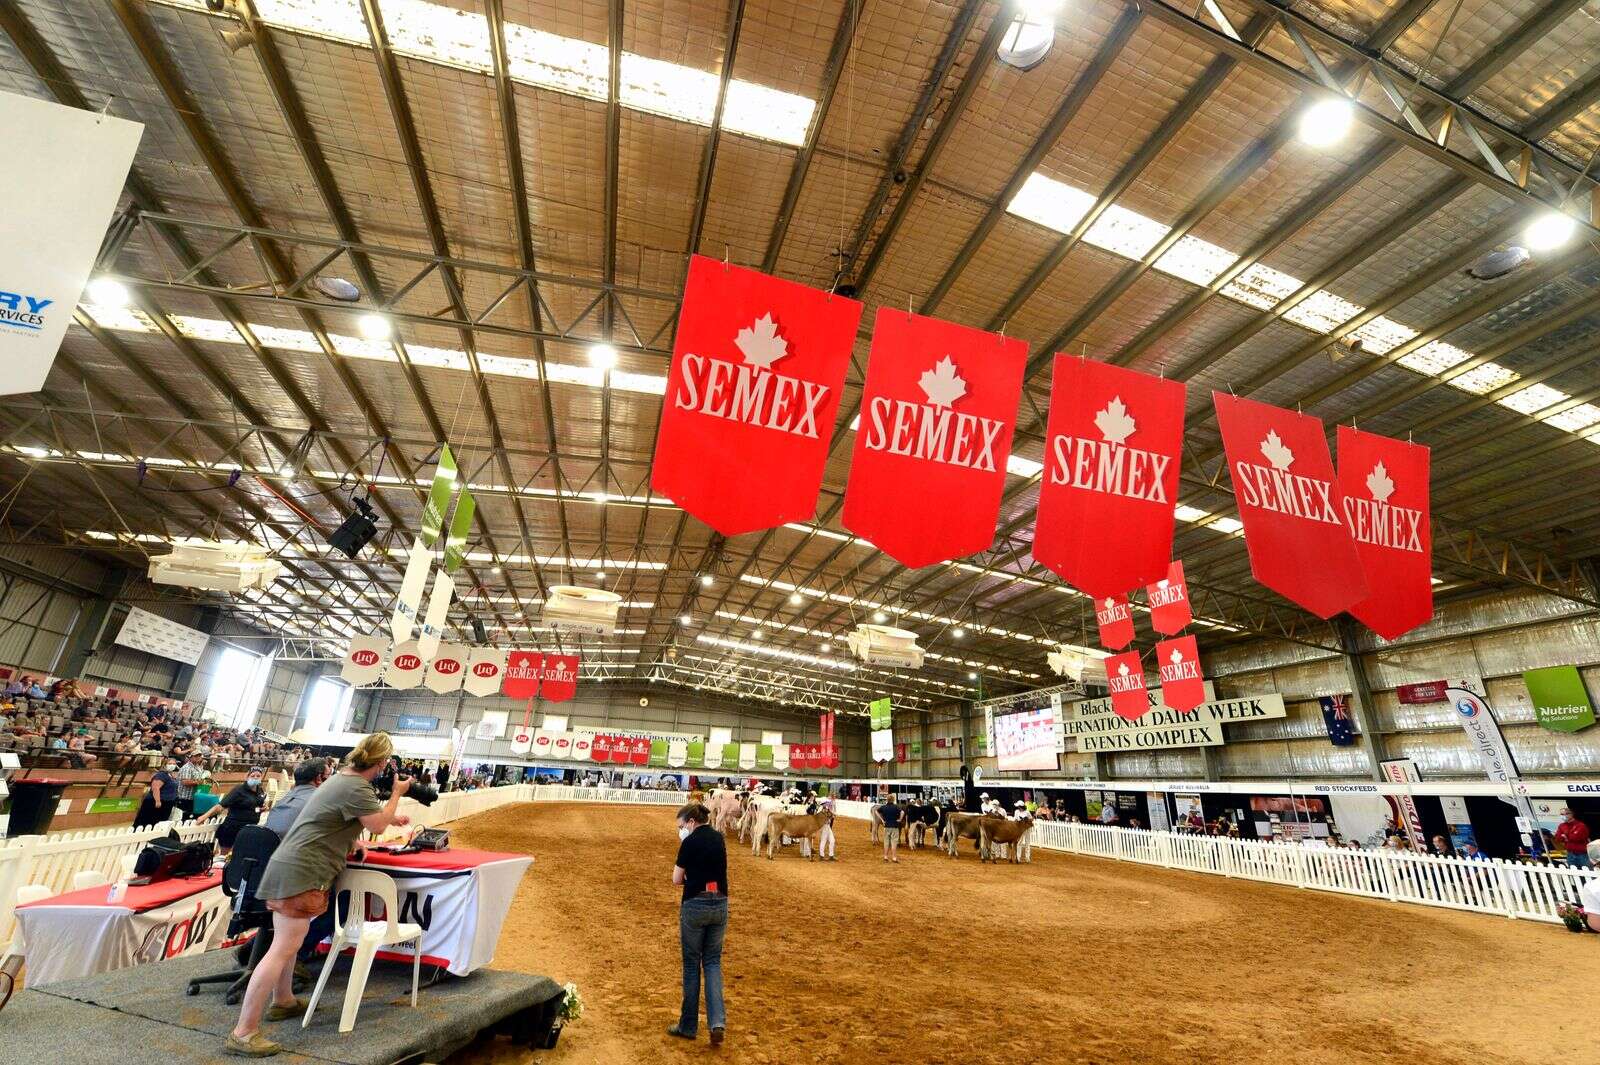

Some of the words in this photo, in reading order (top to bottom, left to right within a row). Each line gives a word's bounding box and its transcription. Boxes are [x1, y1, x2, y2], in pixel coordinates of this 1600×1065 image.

[675, 353, 829, 439] SEMEX
[865, 396, 1004, 472] SEMEX
[1051, 435, 1172, 504] SEMEX
[1236, 461, 1342, 526] SEMEX
[1343, 496, 1423, 553] SEMEX
[1149, 584, 1184, 609] SEMEX
[1097, 604, 1128, 626] SEMEX
[507, 667, 538, 680] SEMEX
[544, 669, 575, 683] SEMEX
[1110, 673, 1143, 693] SEMEX
[1160, 661, 1198, 682] SEMEX
[1080, 699, 1113, 716] Black
[1148, 693, 1158, 707] &
[1539, 704, 1588, 717] Nutrien
[1063, 714, 1147, 735] TERNATIONAL
[1152, 706, 1200, 726] DAIRY
[1207, 699, 1266, 720] WEEK
[1084, 733, 1131, 750] EVENTS
[1136, 727, 1213, 747] COMPLEX
[1567, 784, 1600, 792] EAGLE
